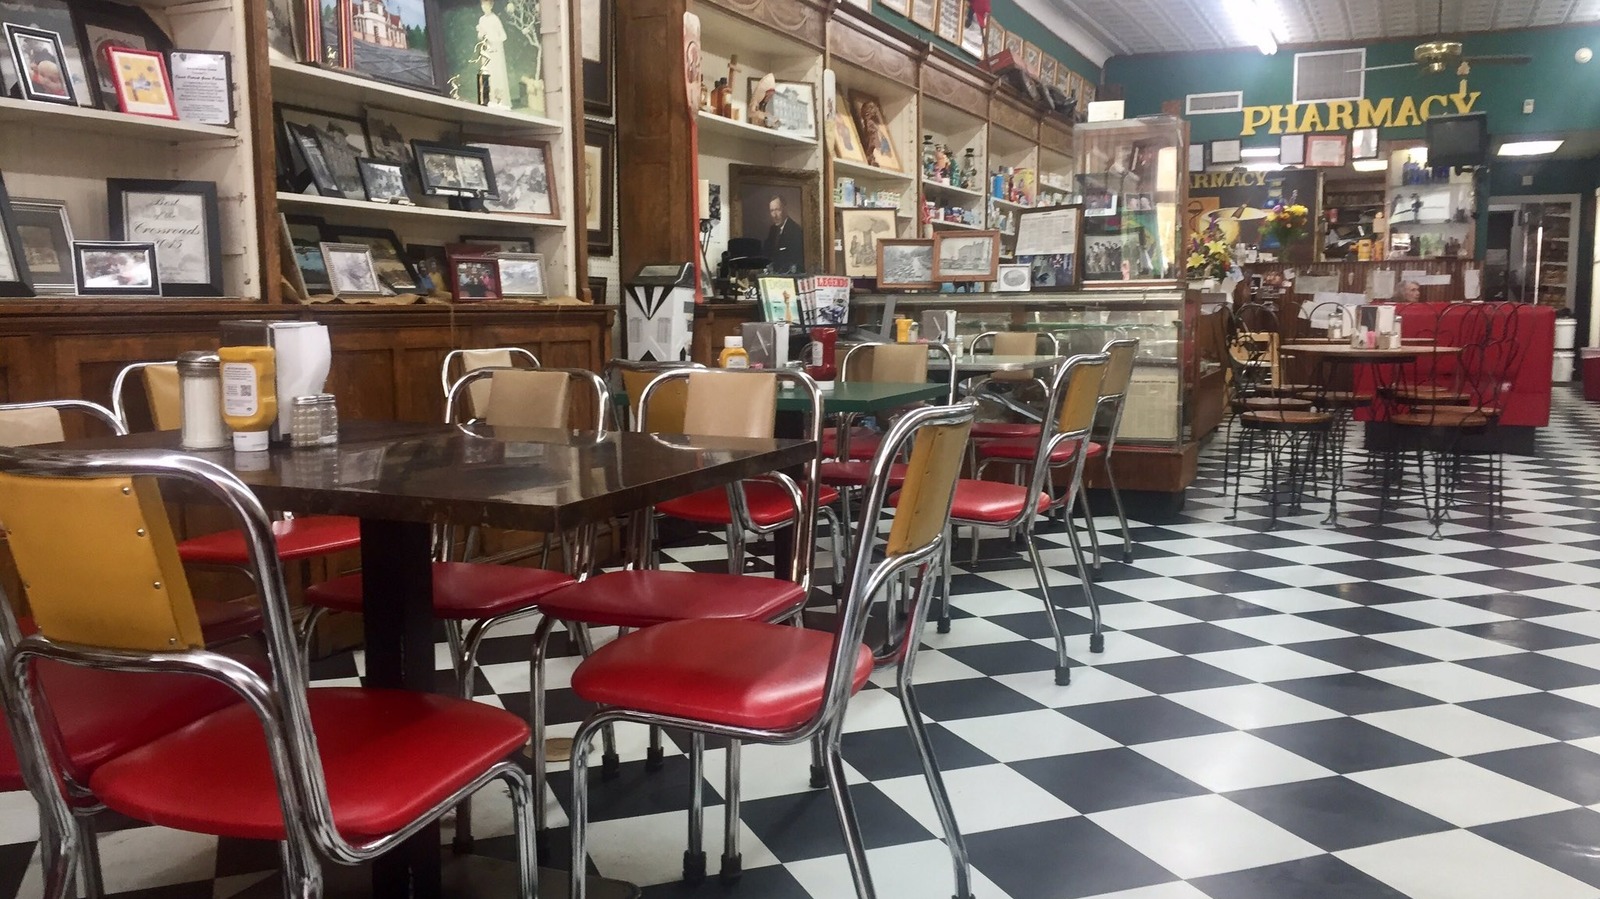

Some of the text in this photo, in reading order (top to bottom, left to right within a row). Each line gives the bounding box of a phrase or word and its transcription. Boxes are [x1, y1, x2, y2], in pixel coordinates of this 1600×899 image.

[1240, 91, 1481, 136] PHARMACY
[152, 197, 180, 206] Best
[134, 222, 200, 235] Crossroads
[817, 277, 848, 288] LEGENDS
